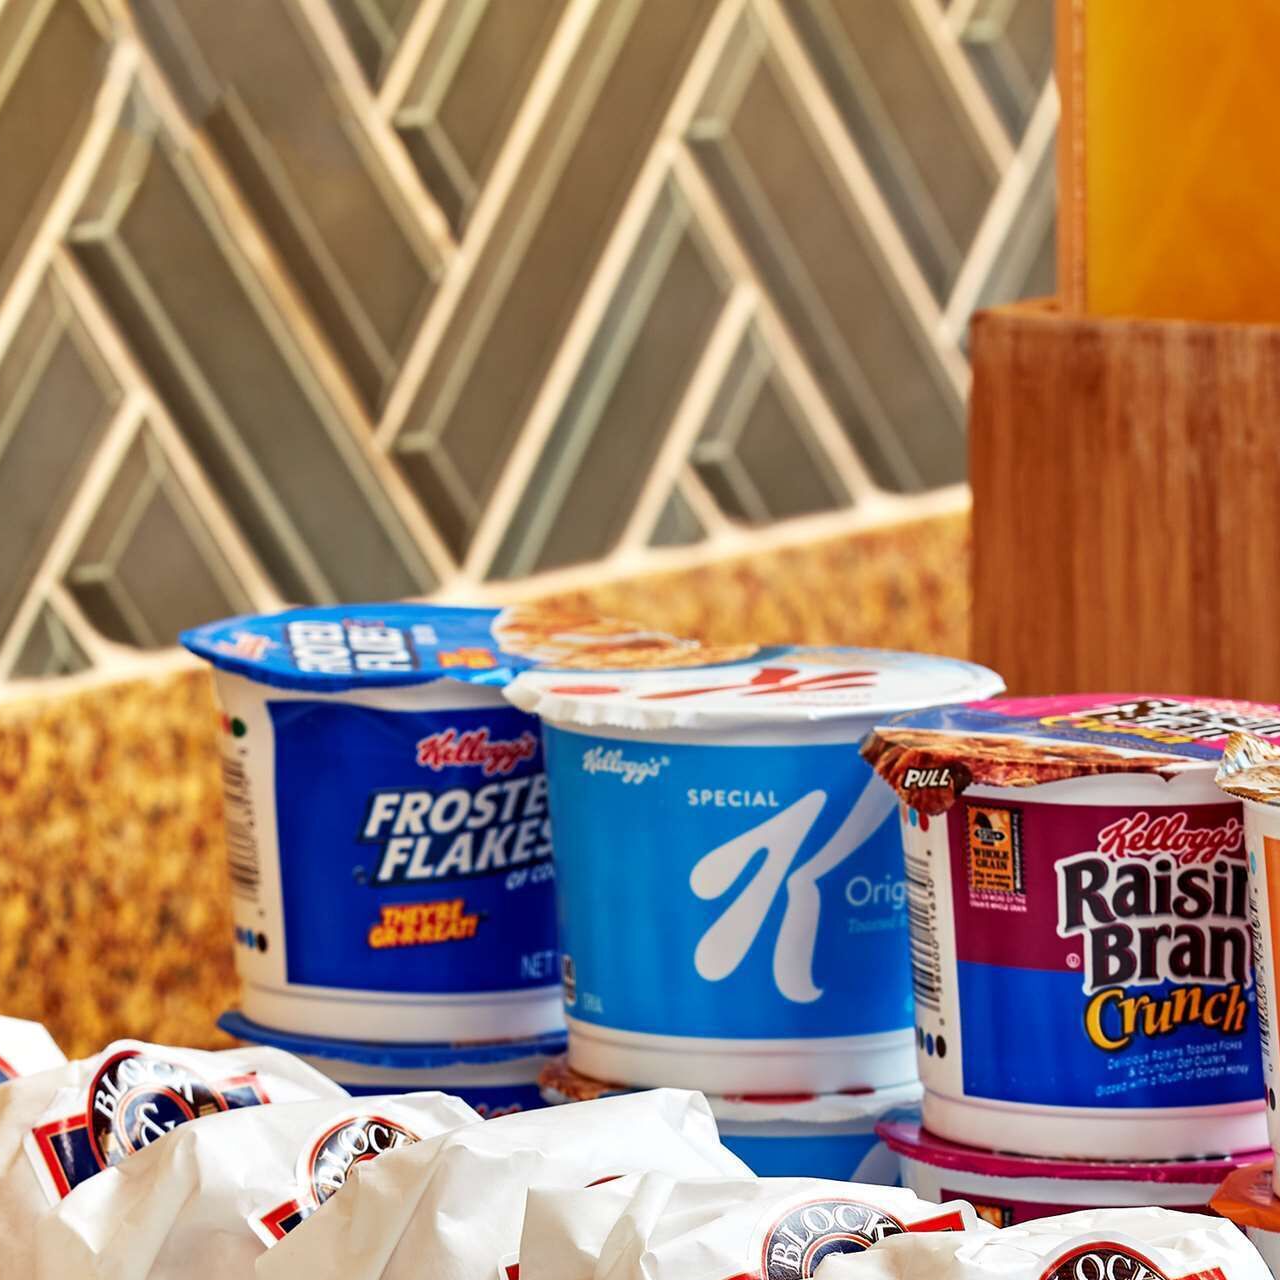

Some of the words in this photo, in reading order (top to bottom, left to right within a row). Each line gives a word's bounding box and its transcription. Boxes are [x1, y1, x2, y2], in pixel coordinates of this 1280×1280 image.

[417, 727, 537, 777] Kellogg's
[582, 748, 661, 785] Kellogg's
[687, 789, 779, 808] SPECIAL
[904, 769, 951, 789] PULL
[364, 772, 550, 838] FROSTE
[973, 848, 1009, 859] WHOLE
[1100, 813, 1243, 864] Kellogg's
[689, 775, 900, 1004] K
[975, 859, 1008, 870] GRAIN
[845, 874, 907, 910] Orig
[1090, 921, 1250, 988] Bran
[1084, 985, 1247, 1051] Crunch
[770, 1204, 901, 1275] BLOCK
